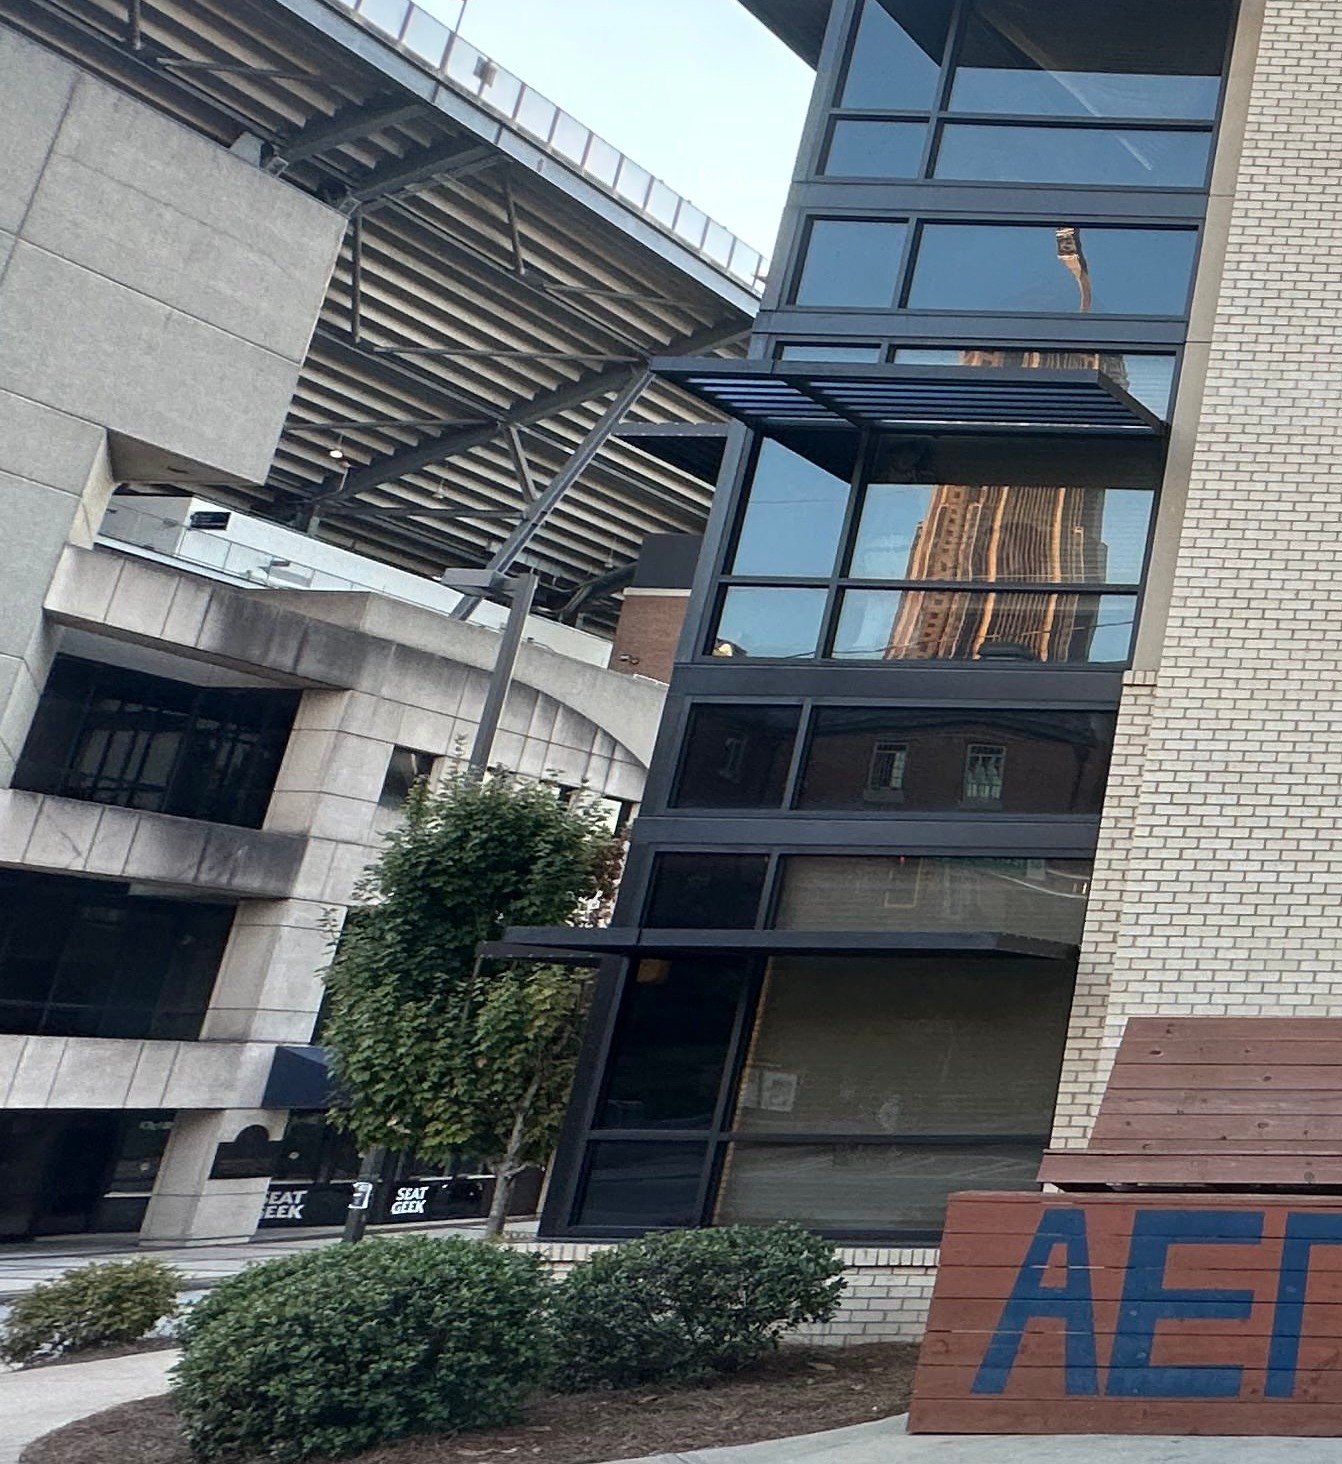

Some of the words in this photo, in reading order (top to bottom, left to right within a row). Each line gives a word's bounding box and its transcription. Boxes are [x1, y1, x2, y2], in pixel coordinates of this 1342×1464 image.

[266, 1190, 308, 1204] EAT
[396, 1186, 428, 1200] SEAT
[262, 1204, 304, 1219] EEK
[391, 1201, 426, 1214] GEEK
